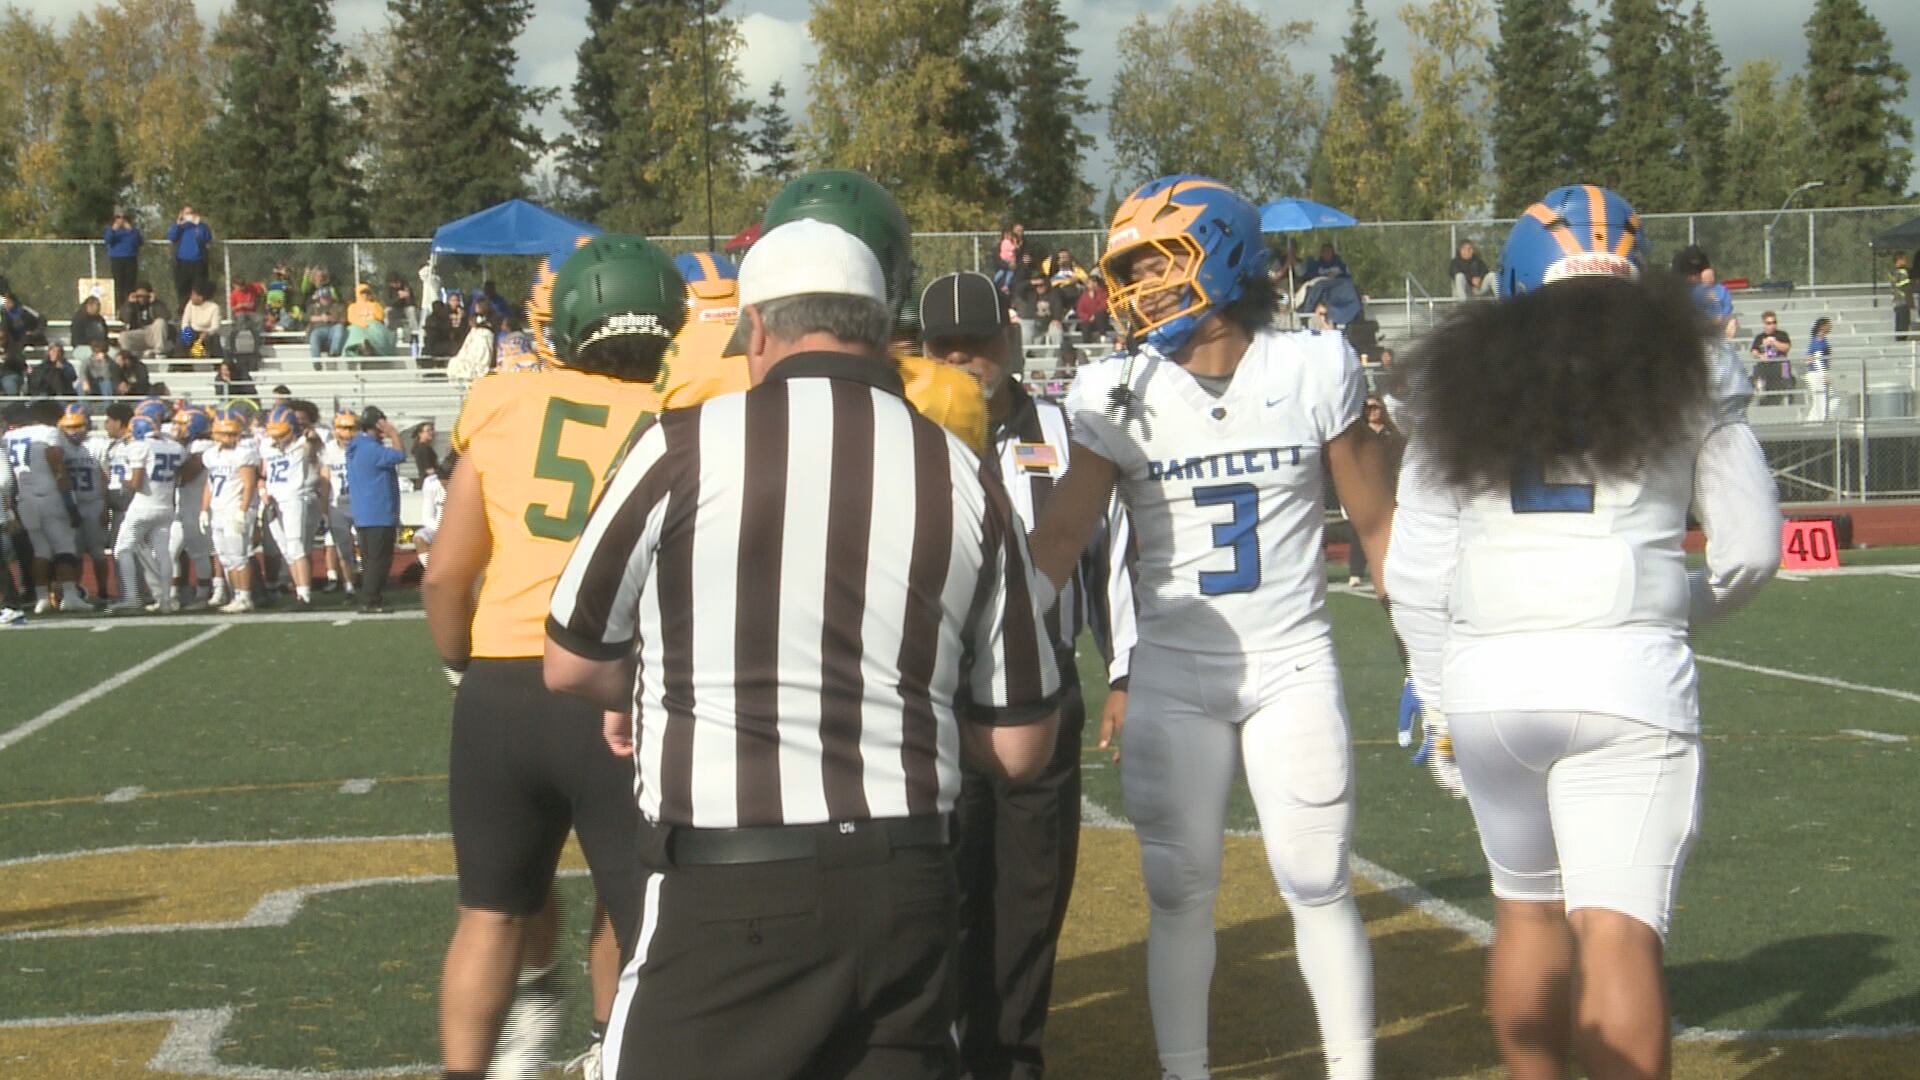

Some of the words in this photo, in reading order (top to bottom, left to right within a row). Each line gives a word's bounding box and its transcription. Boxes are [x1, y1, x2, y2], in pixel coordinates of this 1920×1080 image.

[269, 460, 290, 484] 12
[1192, 481, 1262, 596] 3
[1787, 527, 1831, 561] 40
